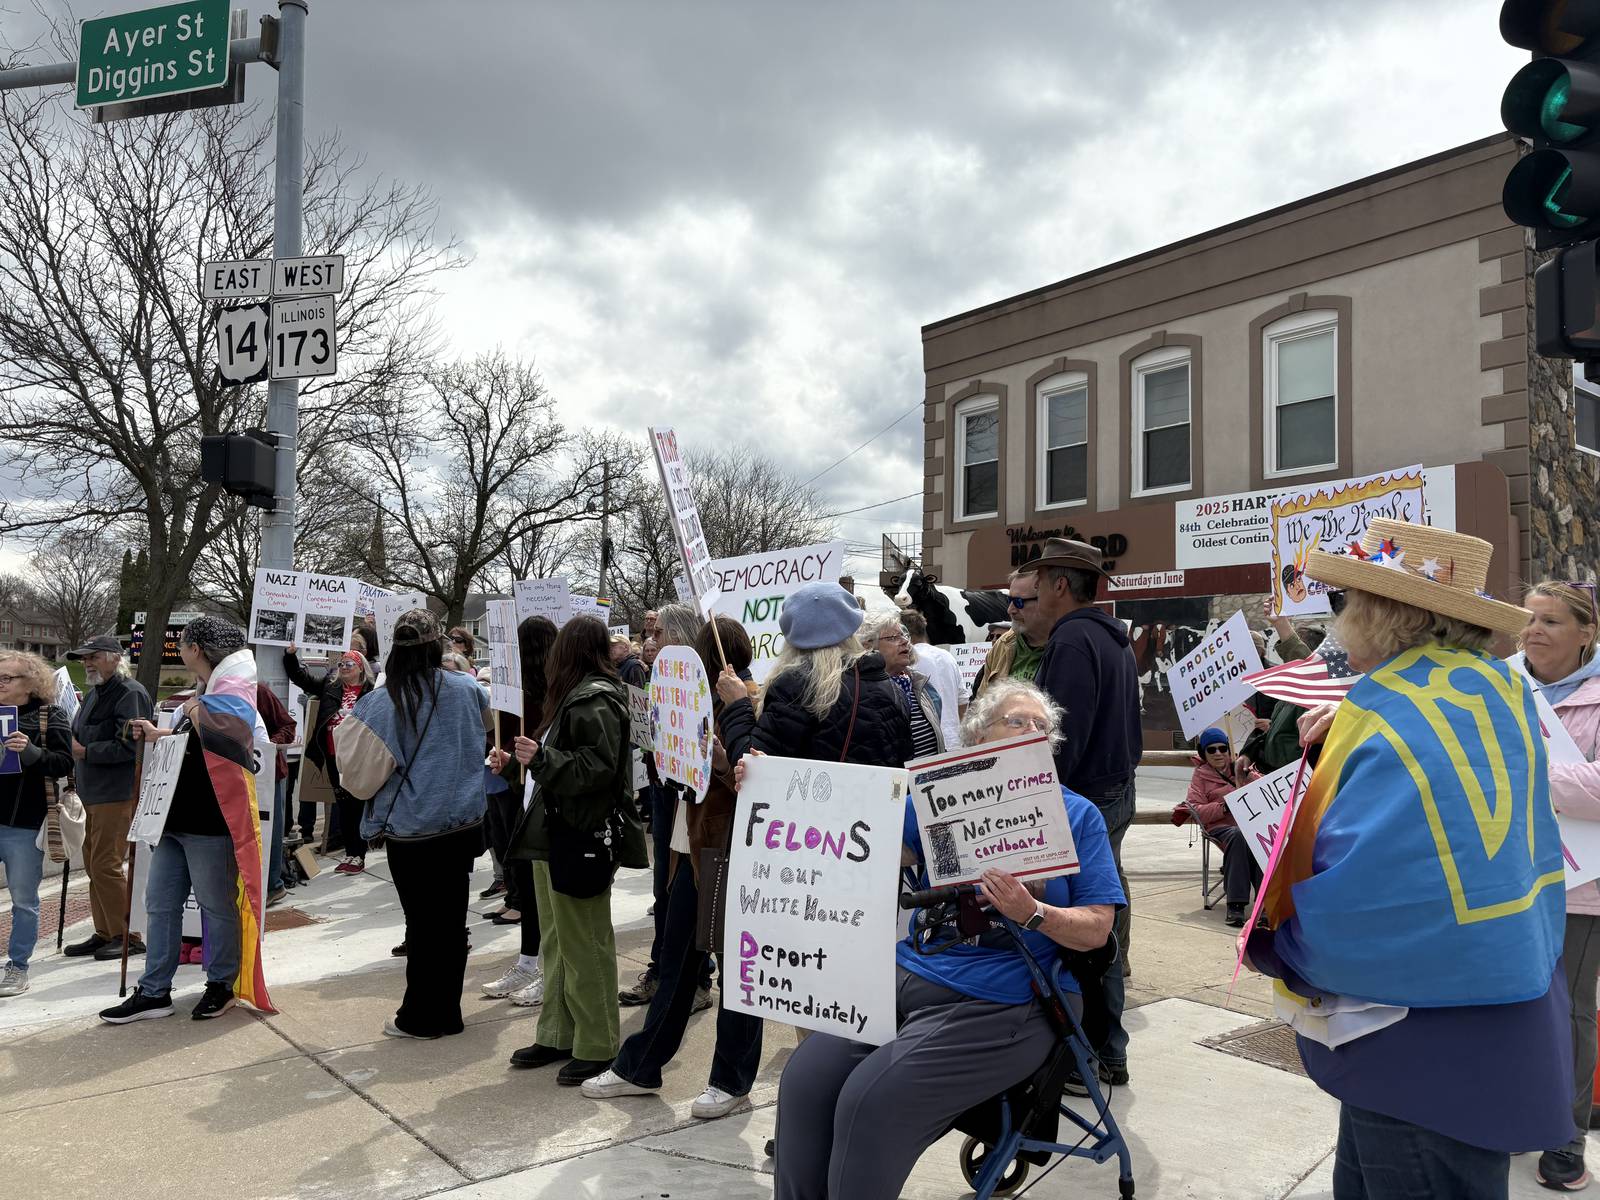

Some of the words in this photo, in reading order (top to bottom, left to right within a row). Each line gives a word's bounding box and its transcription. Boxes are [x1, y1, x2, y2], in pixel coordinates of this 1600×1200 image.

[103, 23, 167, 57] Ayer
[176, 13, 204, 41] St
[88, 58, 178, 97] Diggins
[188, 48, 215, 76] St
[214, 267, 261, 290] EAST
[284, 263, 335, 287] WEST
[281, 307, 326, 324] ILLINOIS
[225, 321, 258, 366] 14
[276, 328, 330, 368] 173
[1196, 501, 1230, 517] 2025
[1063, 525, 1075, 537] to
[1180, 522, 1201, 533] 84th
[1286, 517, 1310, 544] We
[1312, 509, 1346, 543] The
[1193, 539, 1227, 548] Oldest
[265, 572, 297, 586] NAZI
[309, 578, 346, 593] MAGA
[517, 582, 532, 592] The
[534, 583, 545, 592] only
[1116, 574, 1152, 588] Saturday
[1153, 574, 1161, 585] in
[1163, 571, 1183, 585] June
[306, 593, 348, 604] Concentration
[315, 603, 333, 611] Camp
[743, 596, 785, 623] NOT
[1179, 630, 1231, 678] PROTECT
[659, 659, 696, 681] RESPECT
[1190, 650, 1235, 690] PUBLIC
[651, 684, 699, 712] EXISTENCE
[1182, 659, 1247, 713] EDUCATION
[670, 710, 684, 730] OR
[661, 731, 696, 760] EXPECT
[655, 751, 704, 792] RESISTANCE
[786, 768, 832, 801] NO
[921, 785, 958, 817] Too
[962, 784, 1004, 806] many
[1007, 772, 1056, 791] crimes.
[1237, 792, 1262, 821] I
[745, 802, 871, 863] FELONS
[963, 818, 992, 842] Not
[995, 806, 1044, 828] enough
[975, 829, 1048, 859] cardboard.
[752, 861, 771, 880] IN
[740, 885, 800, 916] WHITE
[740, 931, 828, 969] Deport
[740, 960, 793, 992] Elon
[740, 984, 868, 1034] Immediately
